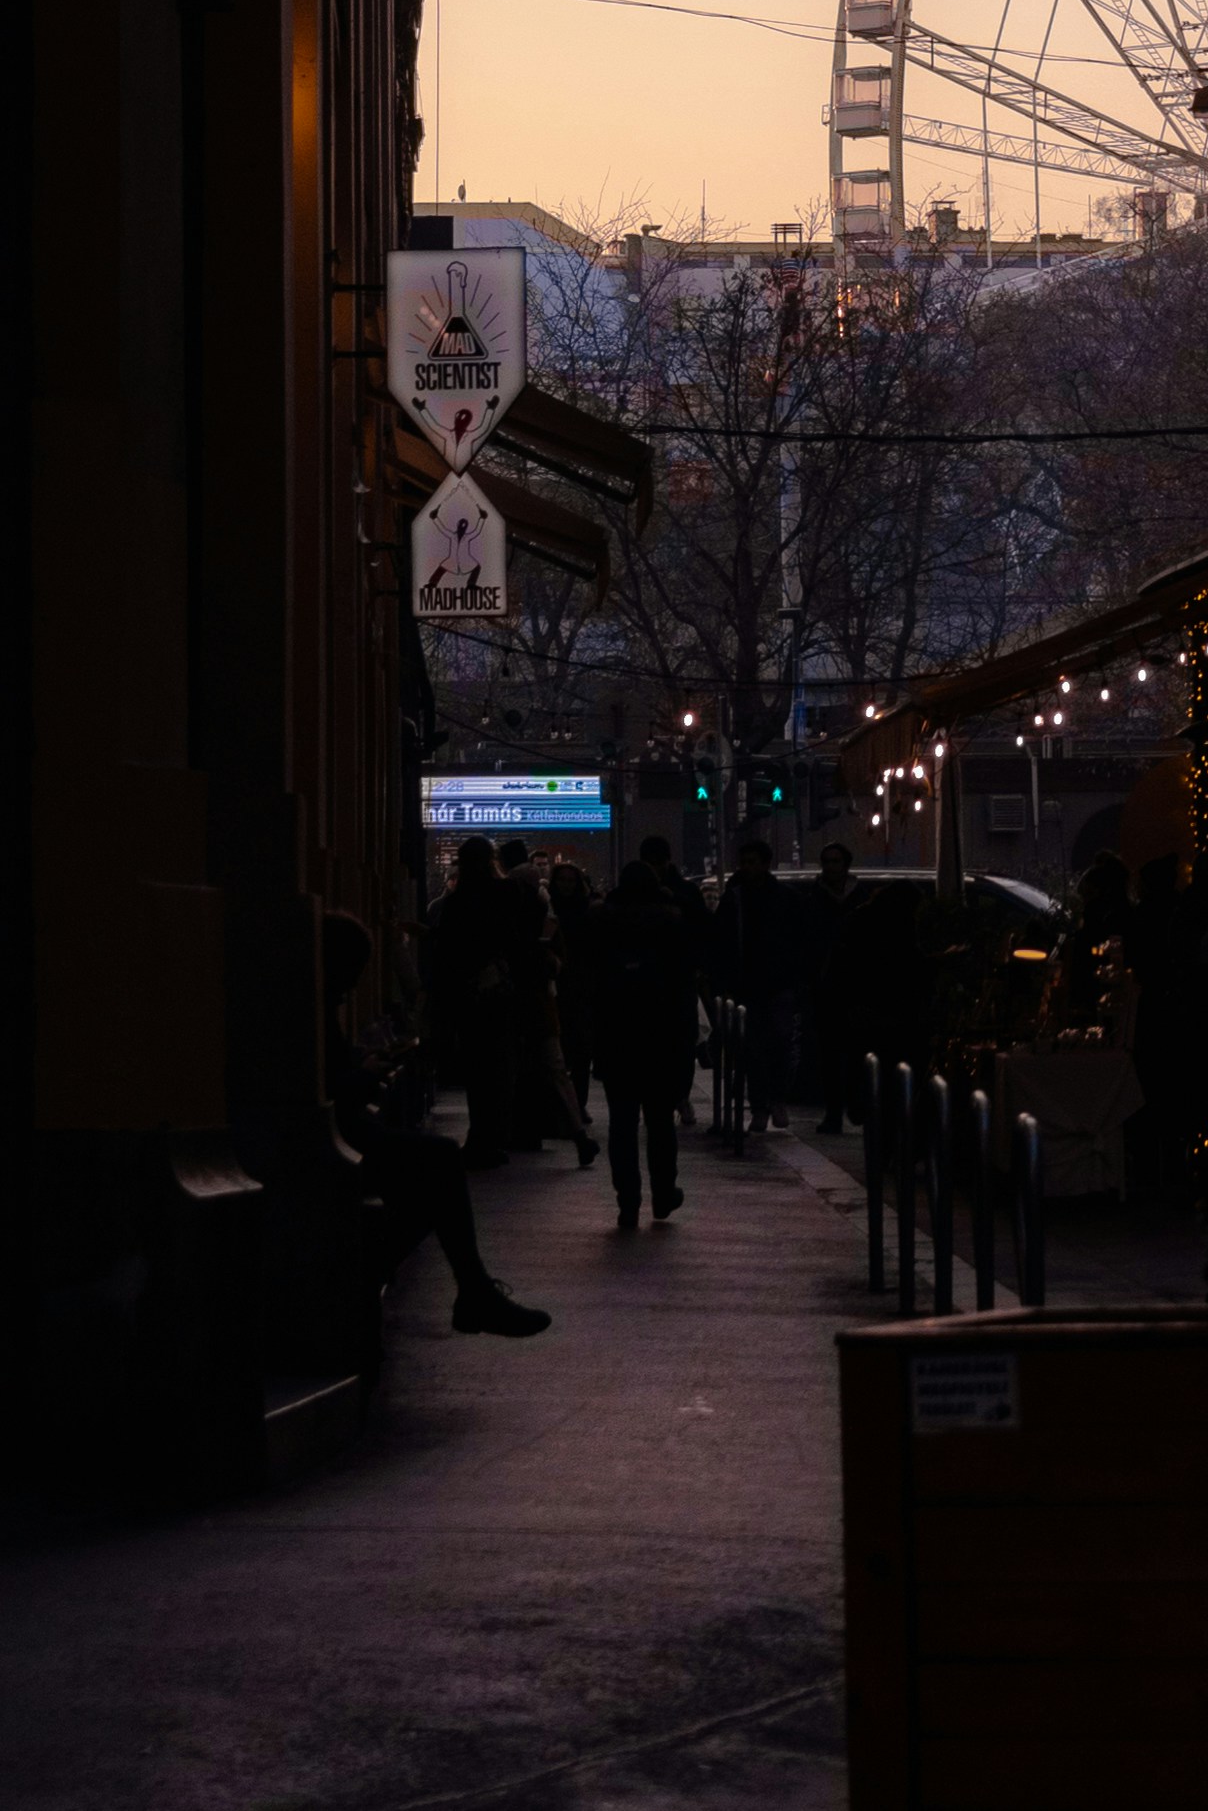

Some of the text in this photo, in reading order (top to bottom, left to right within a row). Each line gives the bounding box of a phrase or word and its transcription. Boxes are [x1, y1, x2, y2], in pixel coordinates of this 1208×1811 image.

[438, 332, 476, 355] MAD
[415, 362, 501, 390] SCIENTIST
[420, 587, 501, 611] MADHOUSE
[461, 802, 522, 822] Tamás
